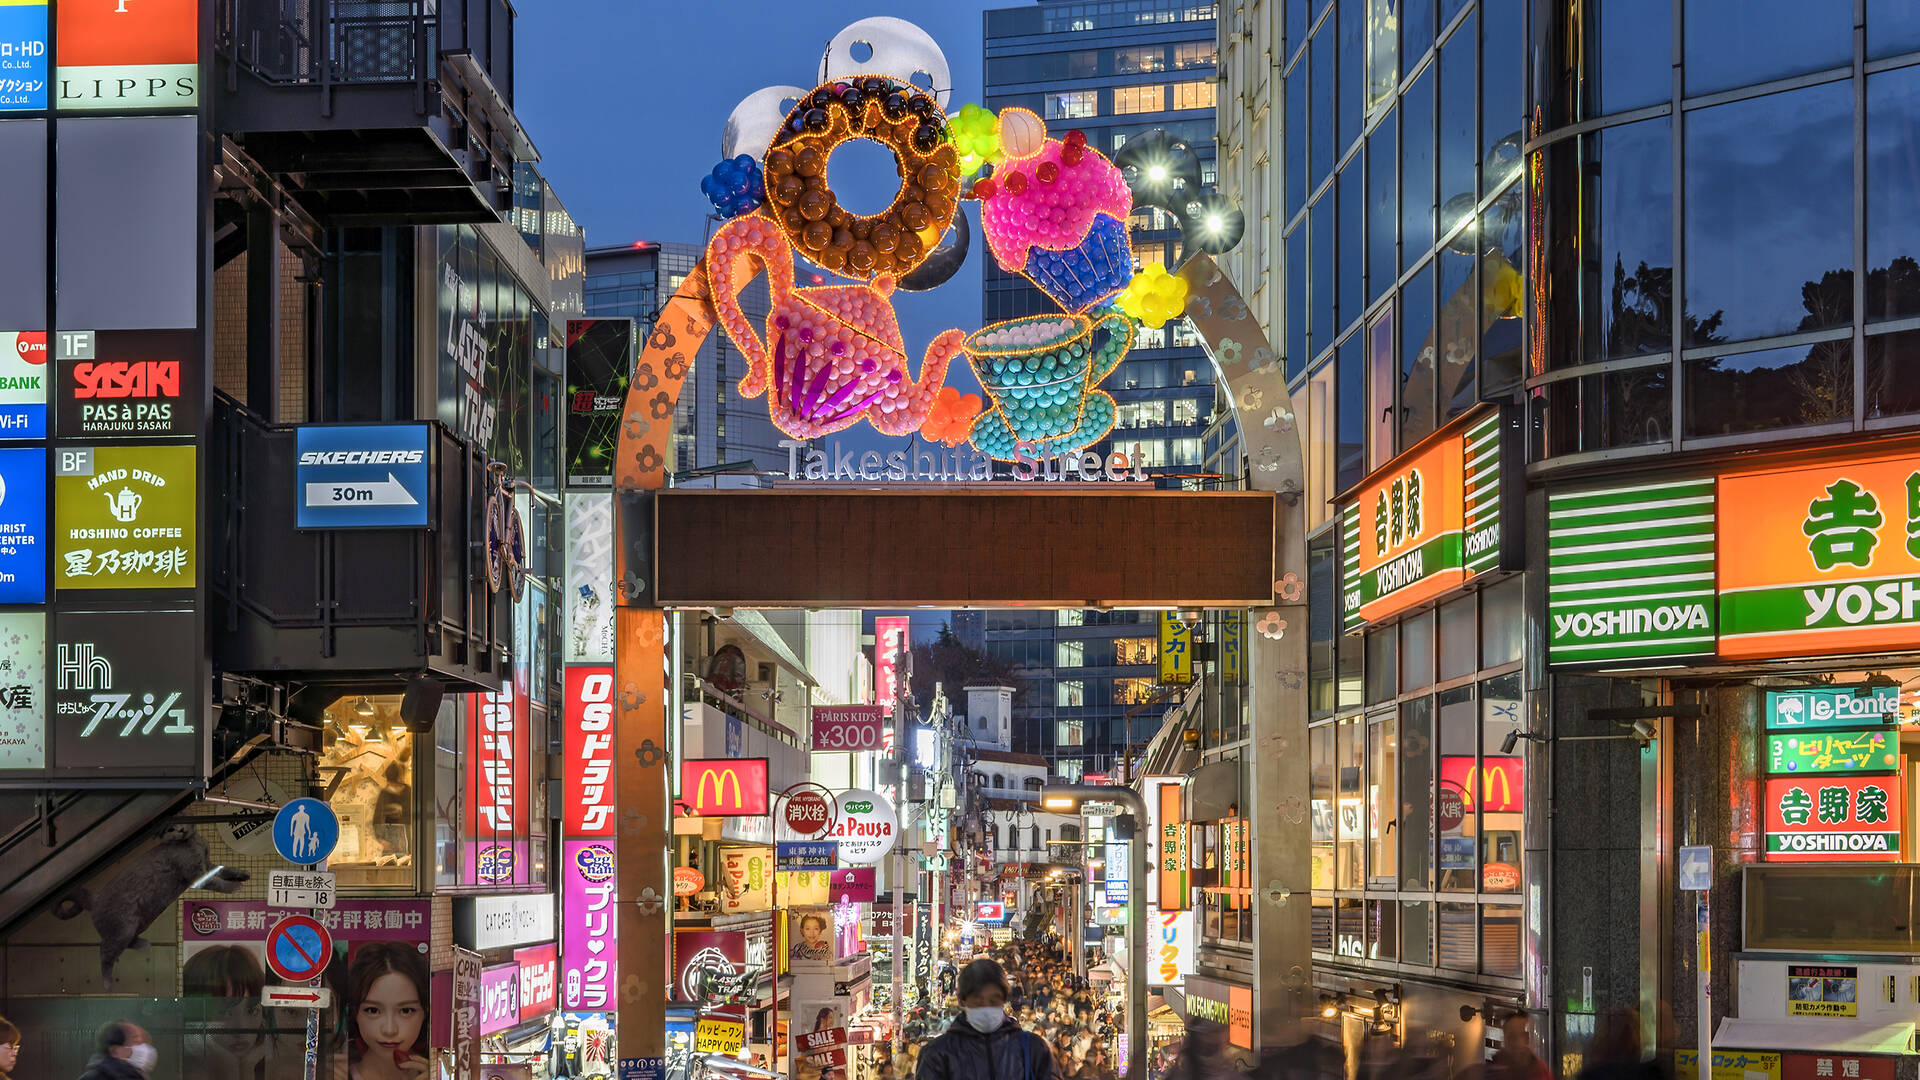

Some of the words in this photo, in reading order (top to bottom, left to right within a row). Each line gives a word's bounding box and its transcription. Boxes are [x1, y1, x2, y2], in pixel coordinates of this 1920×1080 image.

[0, 41, 44, 56] ロ・HD
[61, 78, 194, 98] LIPPS
[63, 335, 87, 356] 1F
[74, 361, 180, 398] SASAKI
[83, 405, 117, 420] PAS
[122, 403, 131, 420] à
[136, 404, 171, 420] PAS
[83, 422, 133, 430] HARAJUKU
[137, 422, 171, 430] SASAKI
[62, 453, 86, 471] BF
[299, 451, 424, 465] SKECHERS
[779, 439, 993, 482] Takeshita
[1012, 441, 1149, 482] Street
[87, 469, 127, 490] HAND
[132, 469, 165, 488] DRIP
[332, 487, 373, 501] 30m
[1376, 468, 1422, 557] 吉野家
[70, 529, 128, 539] HOSHINO
[133, 528, 182, 538] COFFEE
[1803, 478, 1920, 572] 吉
[64, 546, 188, 577] 星乃珈琲
[1376, 549, 1423, 595] YOSHINOYA
[1554, 604, 1709, 639] YOSHINOYA
[57, 643, 112, 689] Hh
[57, 702, 97, 714] はらじゅく
[1836, 693, 1898, 715] Ponte
[80, 692, 194, 737] アッシュ
[821, 711, 849, 721] PARIS
[851, 711, 876, 721] KID'S
[820, 725, 875, 747] ¥300
[581, 674, 613, 831] OSドラッグ
[1799, 739, 1885, 756] ビリヤード
[1812, 753, 1870, 769] ダーツ
[789, 804, 825, 821] 消火栓
[1779, 785, 1888, 825] 吉野家
[828, 817, 844, 836] La
[848, 817, 891, 838] Pausa
[1164, 824, 1176, 870] 吉野家
[1779, 835, 1887, 850] YOSHINOYA
[273, 874, 332, 888] 自転車を除く
[276, 891, 288, 903] 11
[315, 892, 328, 904] 18
[458, 959, 480, 979] OPEN
[712, 975, 742, 983] LASER
[718, 985, 743, 993] TRAP
[1186, 993, 1214, 1021] WOLFGANG
[699, 1024, 741, 1038] ハッピーワン
[807, 1031, 834, 1046] SALE
[697, 1039, 721, 1050] HAPPY
[724, 1041, 740, 1052] ONE
[1763, 1062, 1775, 1070] 3F
[1817, 1058, 1859, 1078] 禁煙
